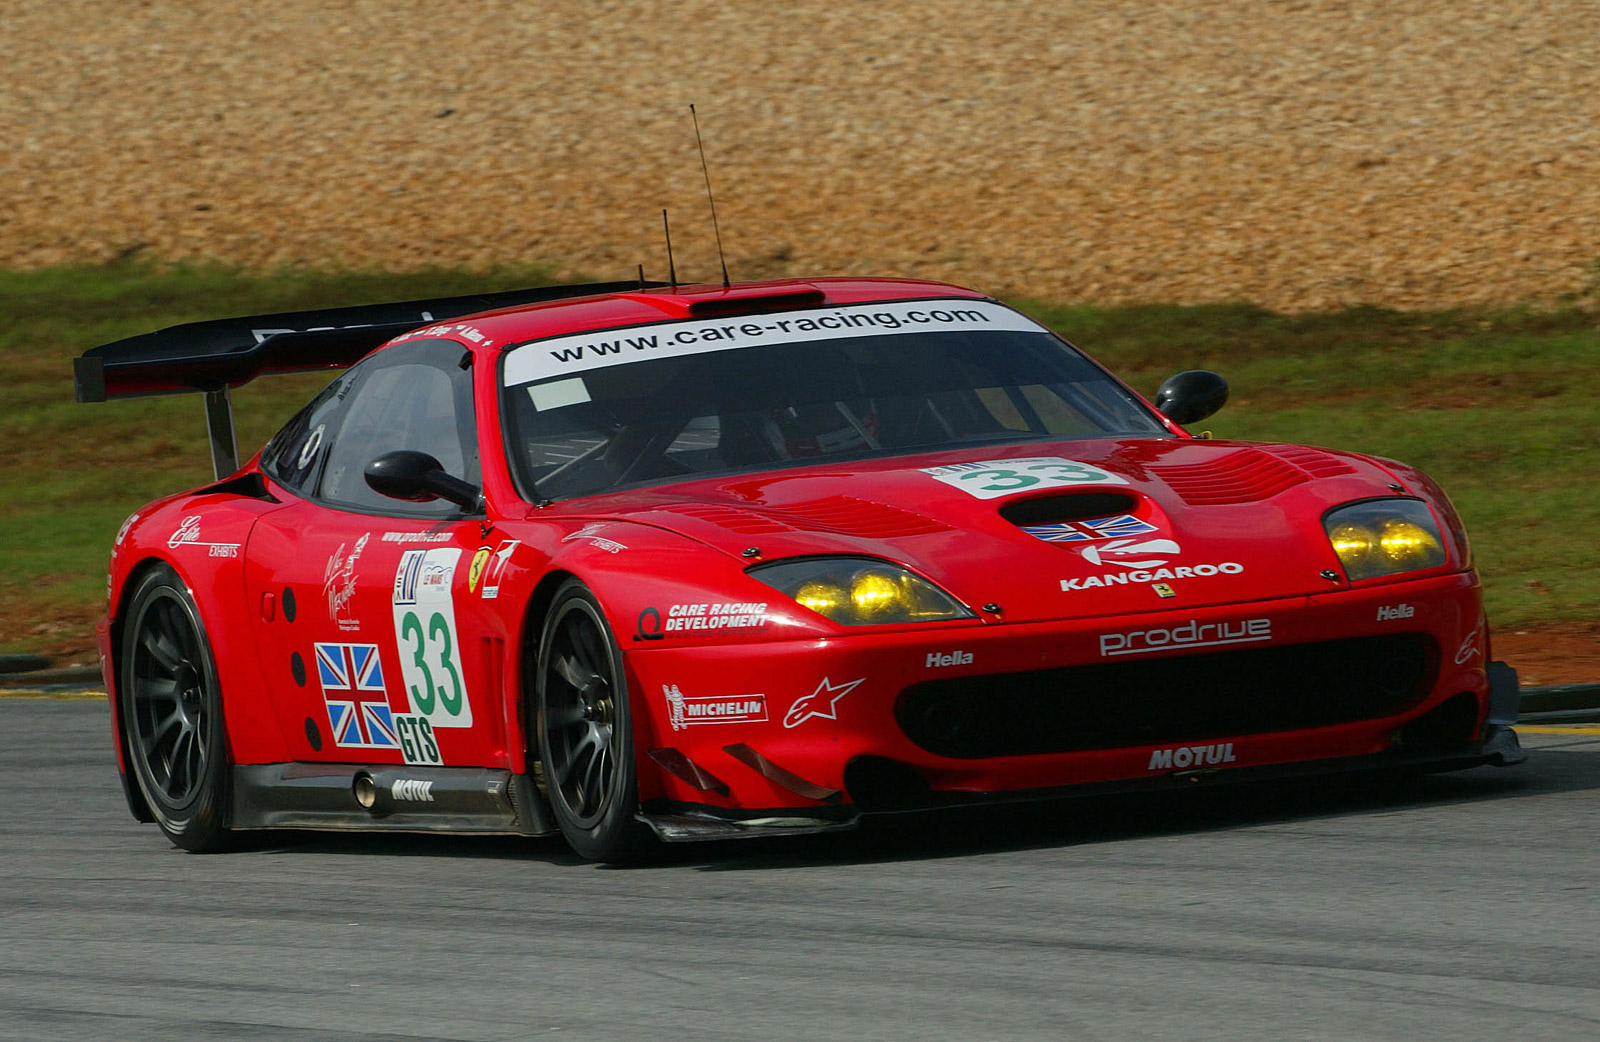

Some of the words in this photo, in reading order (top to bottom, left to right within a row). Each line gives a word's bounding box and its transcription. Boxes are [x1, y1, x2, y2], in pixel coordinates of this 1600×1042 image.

[550, 304, 990, 363] www.care-racing.com
[960, 464, 1109, 491] 33
[1060, 562, 1244, 592] KANGAROO
[665, 614, 769, 631] DEVELOPMENT
[669, 604, 708, 617] CARE
[709, 602, 768, 616] RACING
[1377, 603, 1415, 621] Hella
[1100, 618, 1272, 657] prodrive
[402, 611, 462, 716] 33
[926, 650, 973, 668] Hella
[688, 701, 762, 717] MICHELIN
[396, 716, 439, 762] GTS
[1148, 743, 1236, 770] MOTUL
[392, 779, 435, 801] MOTUL
